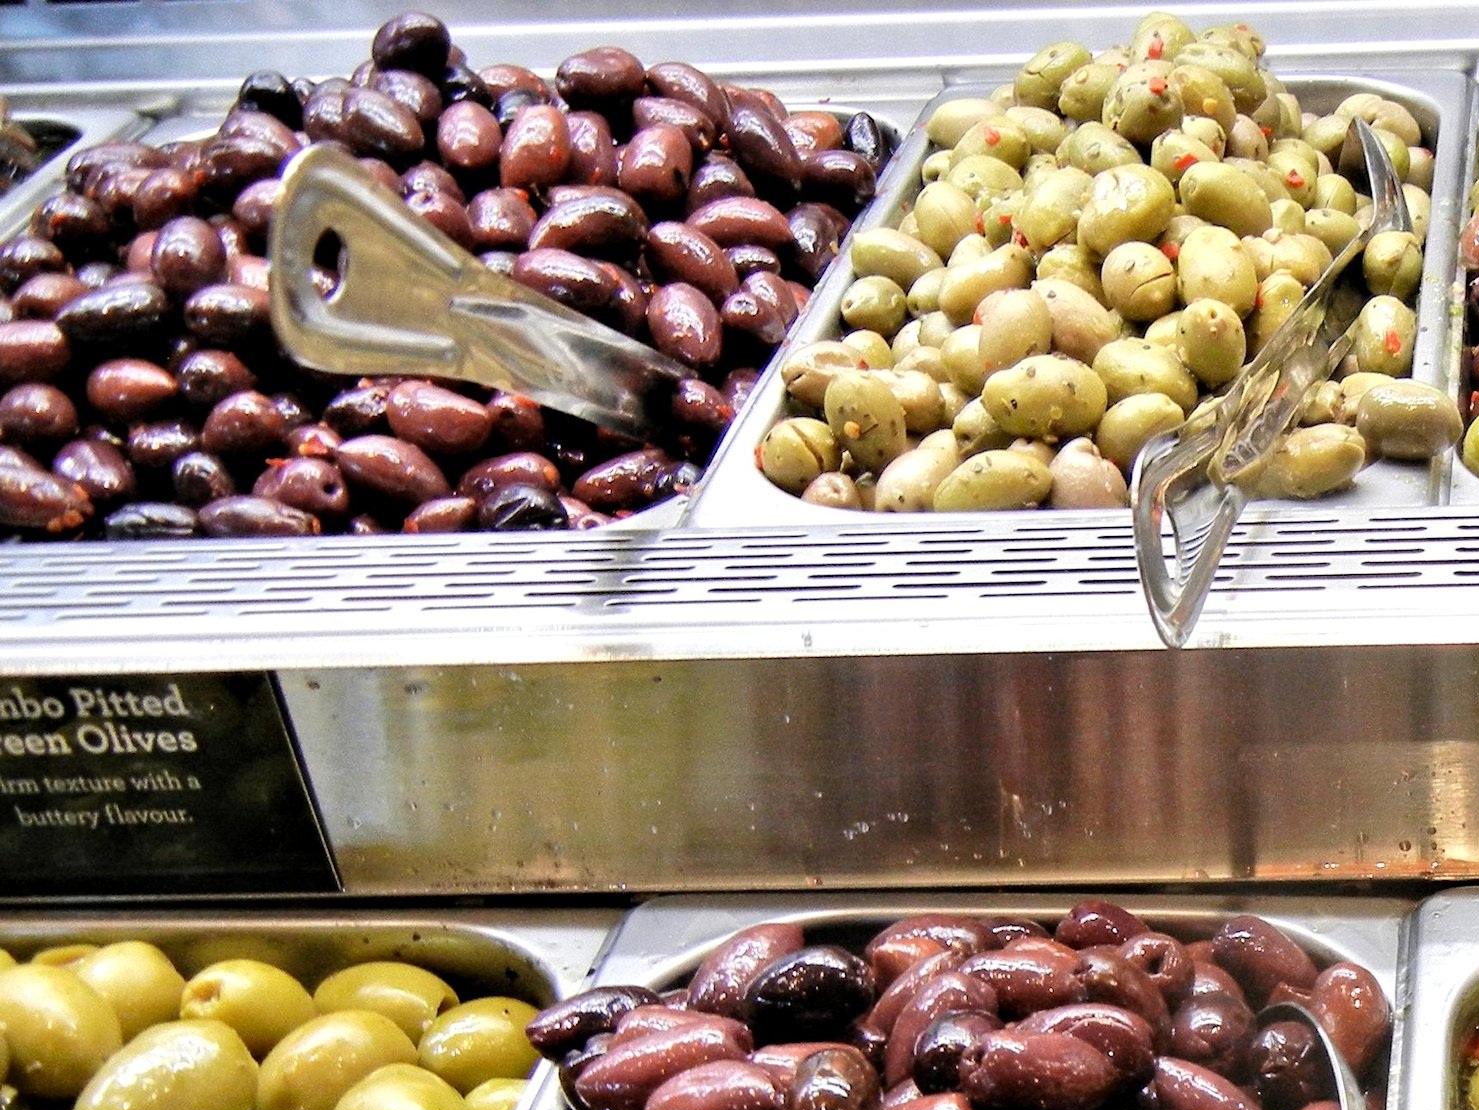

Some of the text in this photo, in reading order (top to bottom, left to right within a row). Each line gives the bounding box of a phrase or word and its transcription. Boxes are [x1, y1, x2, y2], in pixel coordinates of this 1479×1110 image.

[69, 683, 189, 718] Pitted
[0, 722, 198, 755] een Olives
[44, 775, 125, 793] texture
[131, 770, 181, 791] with
[187, 777, 201, 790] a
[15, 804, 194, 829] buttery flavour.
